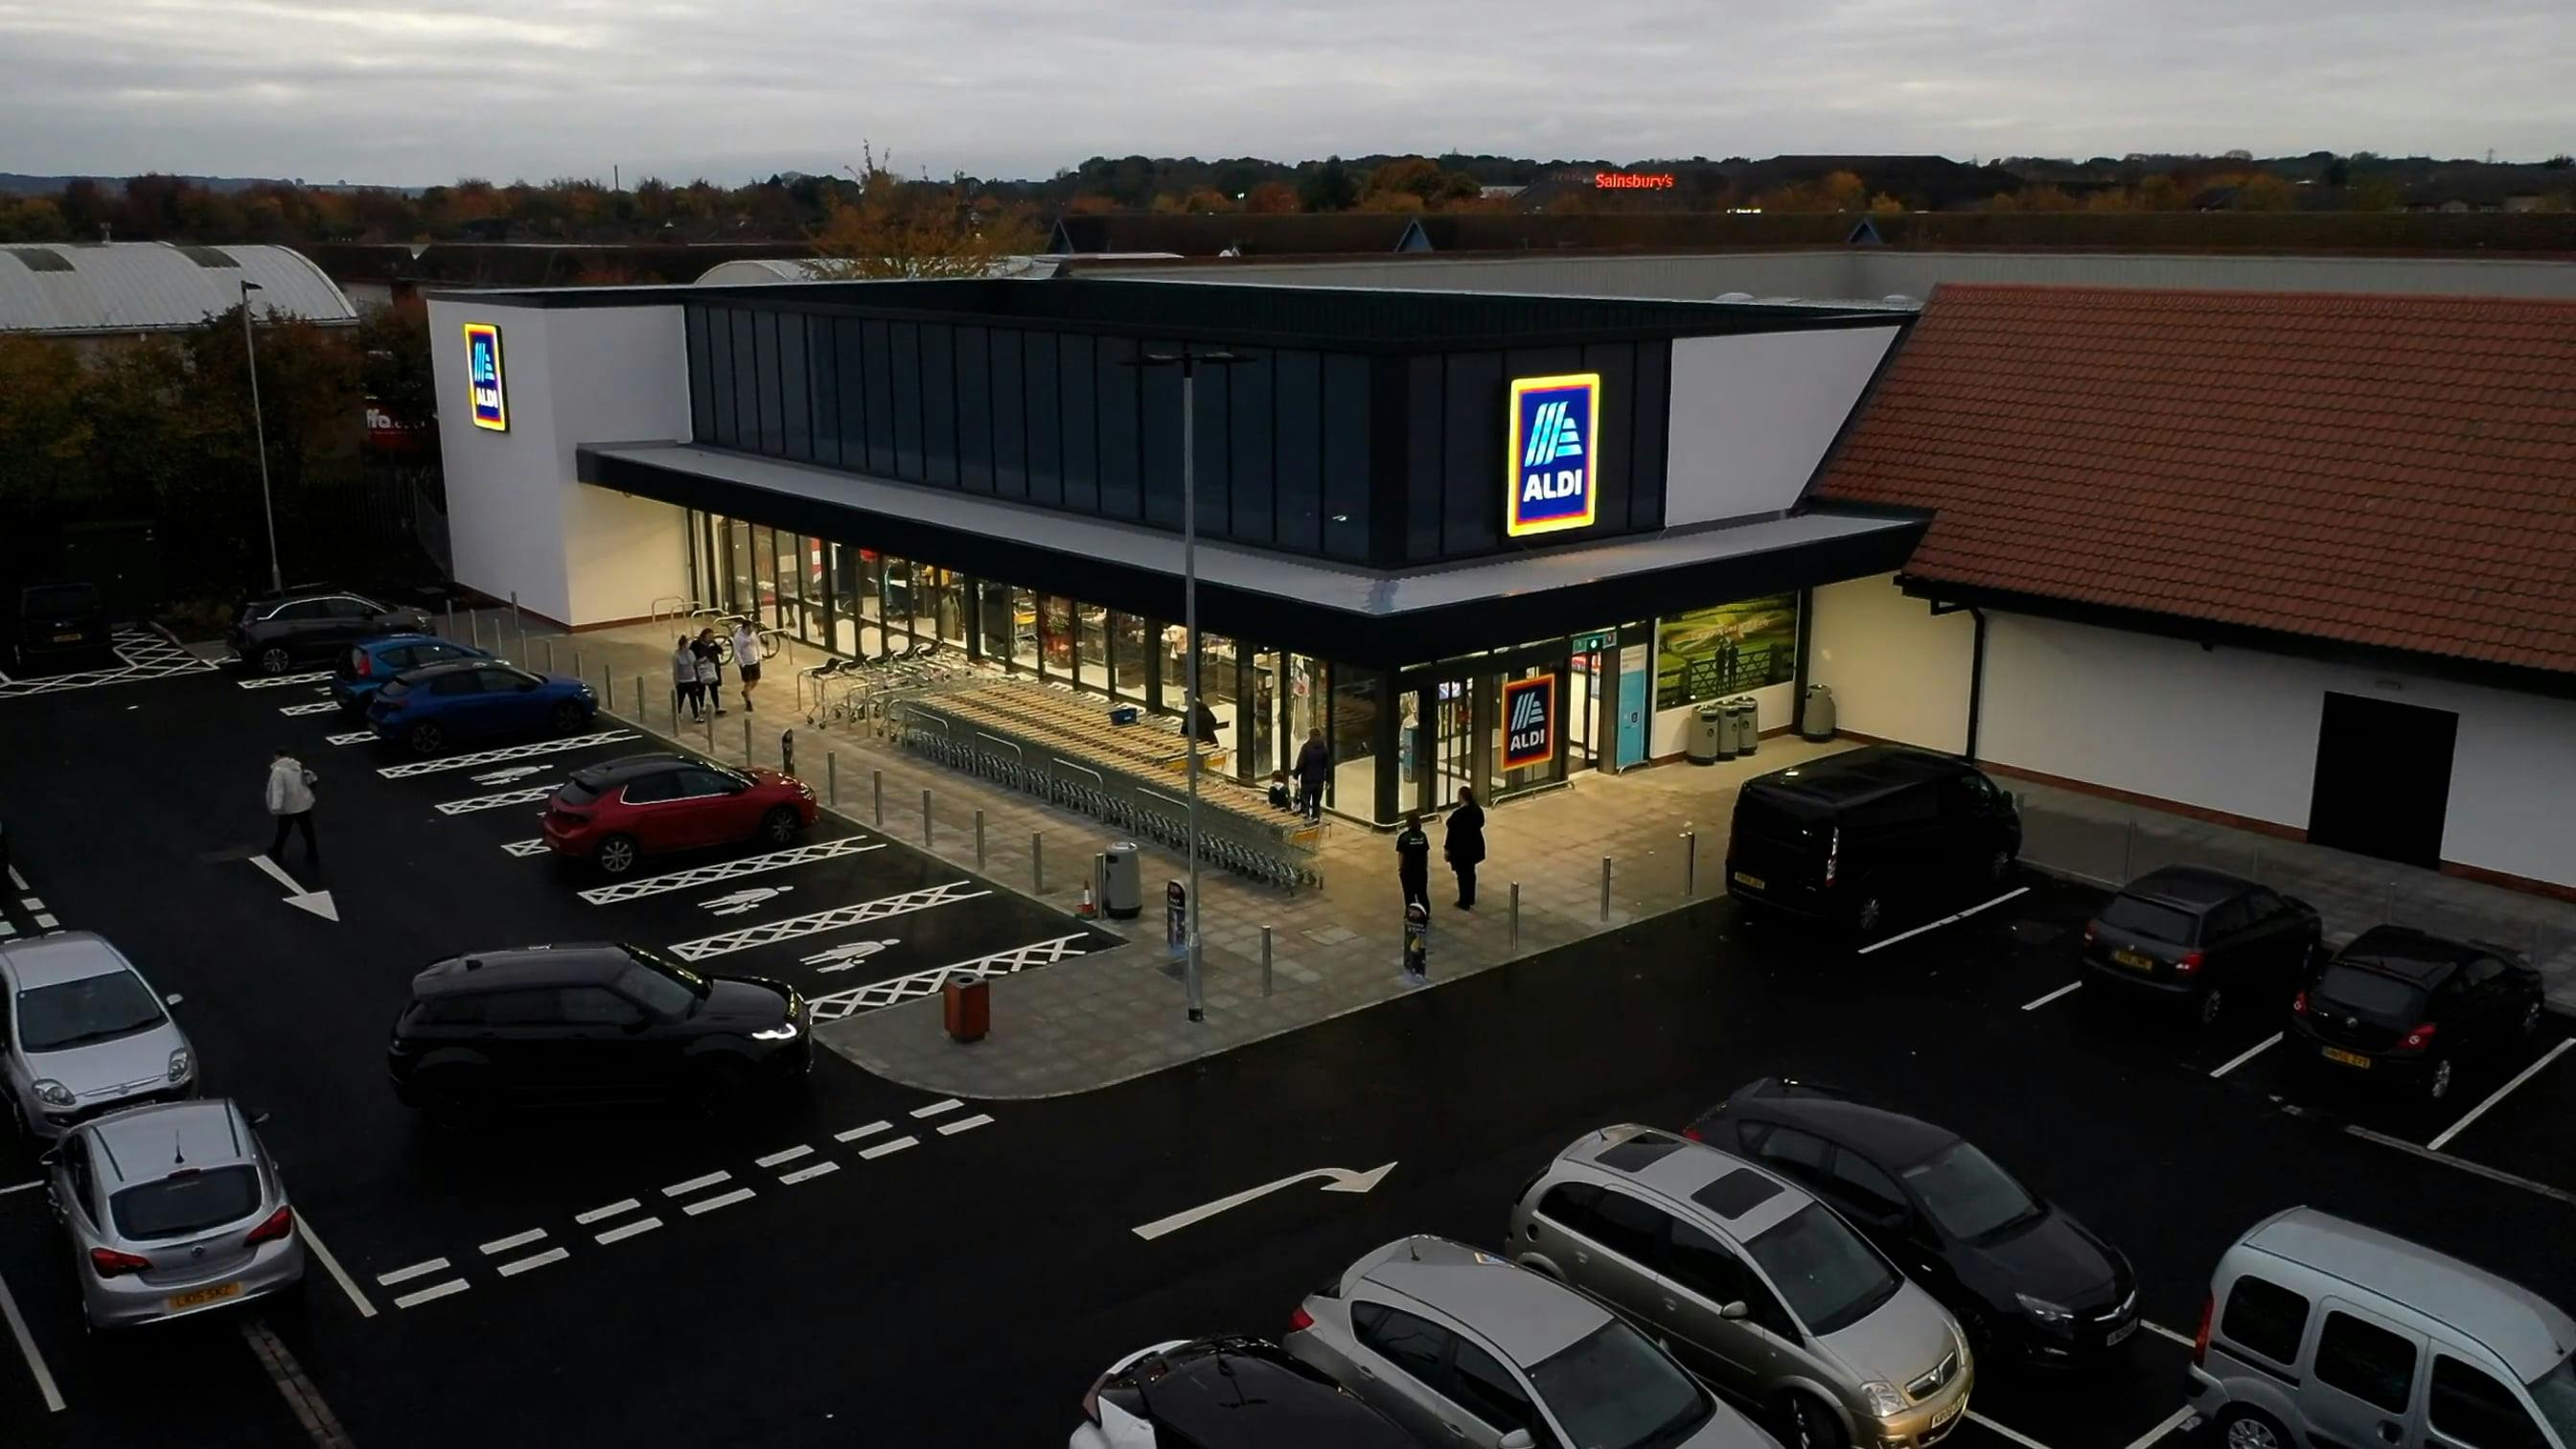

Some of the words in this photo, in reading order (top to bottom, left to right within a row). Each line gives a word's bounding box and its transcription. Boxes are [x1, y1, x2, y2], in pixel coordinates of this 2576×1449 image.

[1596, 173, 1673, 191] Sainsbury's
[476, 387, 498, 408] ALDI
[1523, 469, 1582, 502] ALDI
[1510, 728, 1545, 751] ALDI
